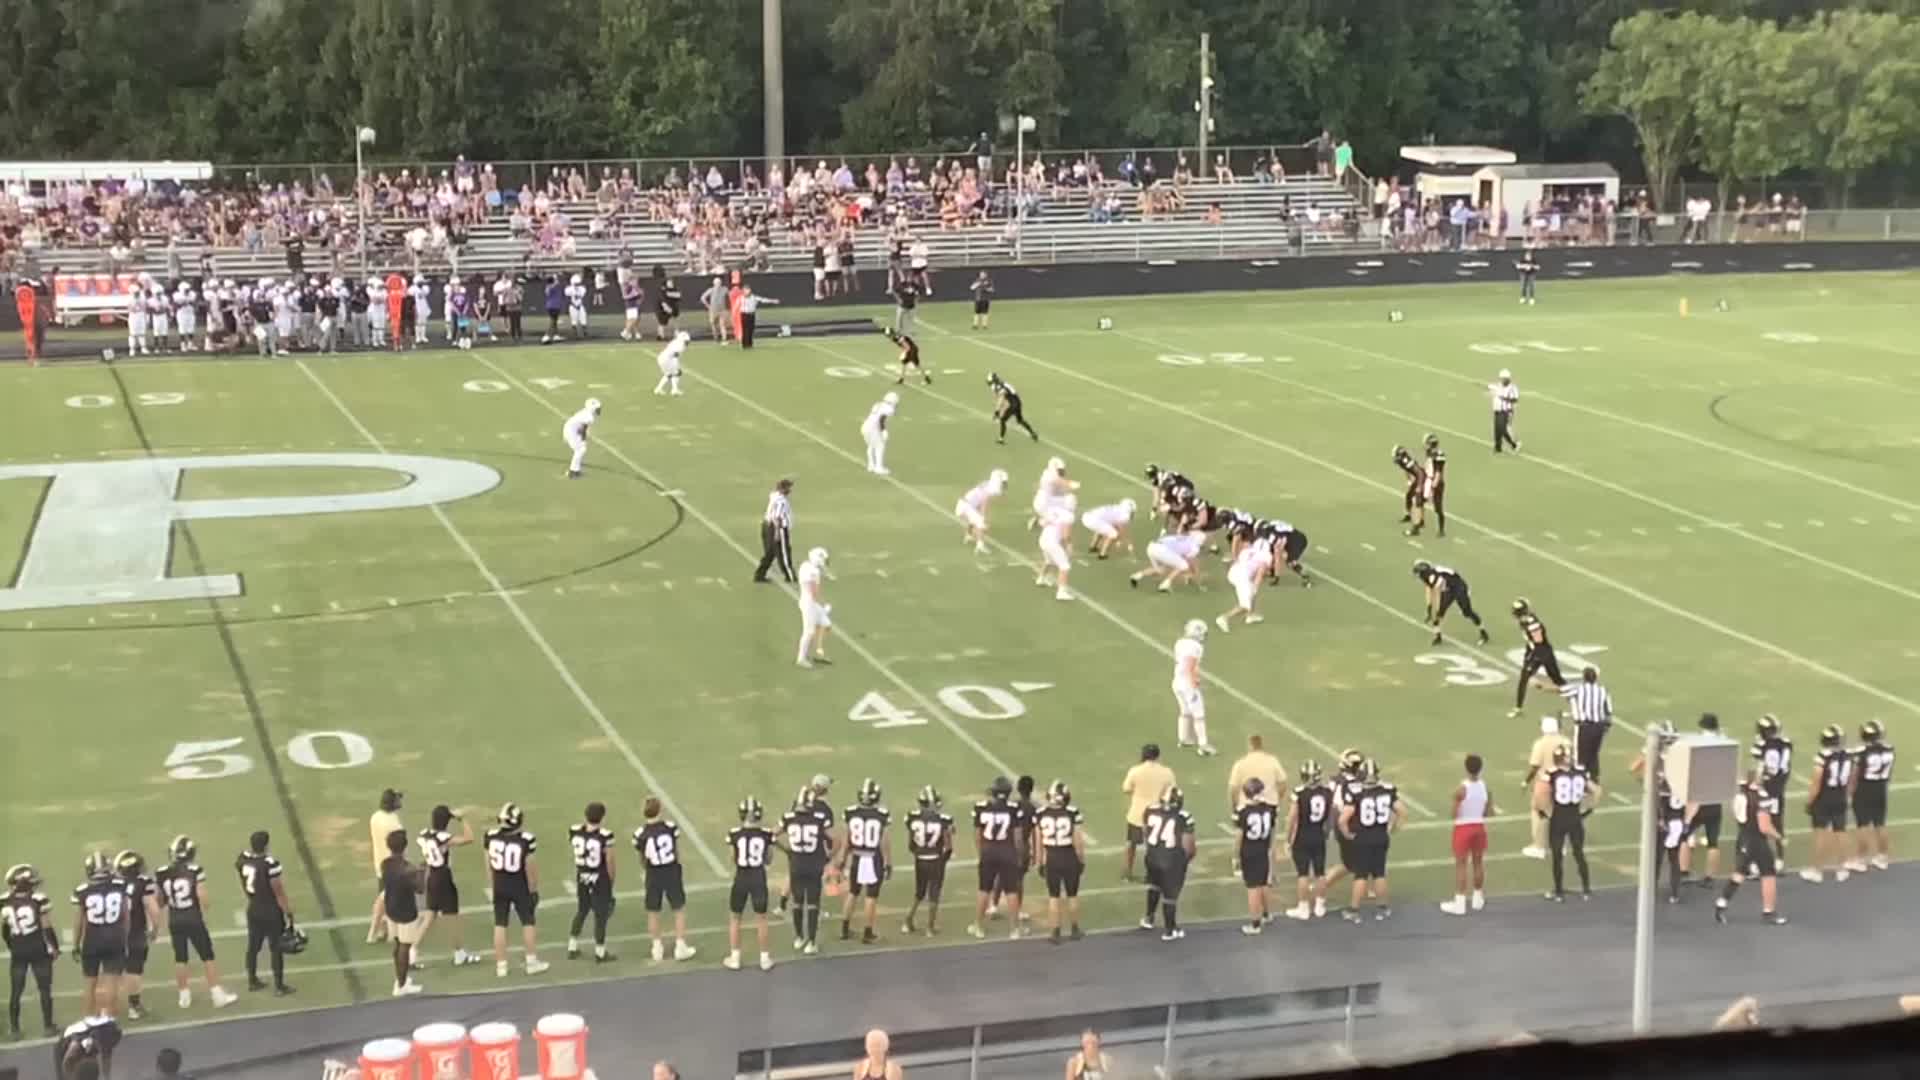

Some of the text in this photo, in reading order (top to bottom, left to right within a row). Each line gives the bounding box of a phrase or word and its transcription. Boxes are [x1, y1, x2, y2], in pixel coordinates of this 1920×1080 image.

[848, 685, 1028, 730] 40
[164, 731, 374, 779] 50
[1554, 775, 1584, 804] 88
[1310, 795, 1326, 823] 9
[1361, 794, 1392, 827] 65
[787, 823, 819, 853] 25
[849, 817, 881, 848] 80
[911, 820, 942, 848] 37
[979, 811, 1011, 841] 77
[1040, 815, 1073, 846] 22
[1147, 815, 1177, 849] 74
[1246, 812, 1271, 840] 31
[488, 841, 522, 873] 50
[571, 835, 602, 868] 23
[647, 834, 675, 867] 42
[736, 836, 765, 868] 19
[163, 878, 193, 909] 12
[242, 865, 257, 894] 7
[0, 905, 37, 937] 12
[85, 892, 122, 925] 28
